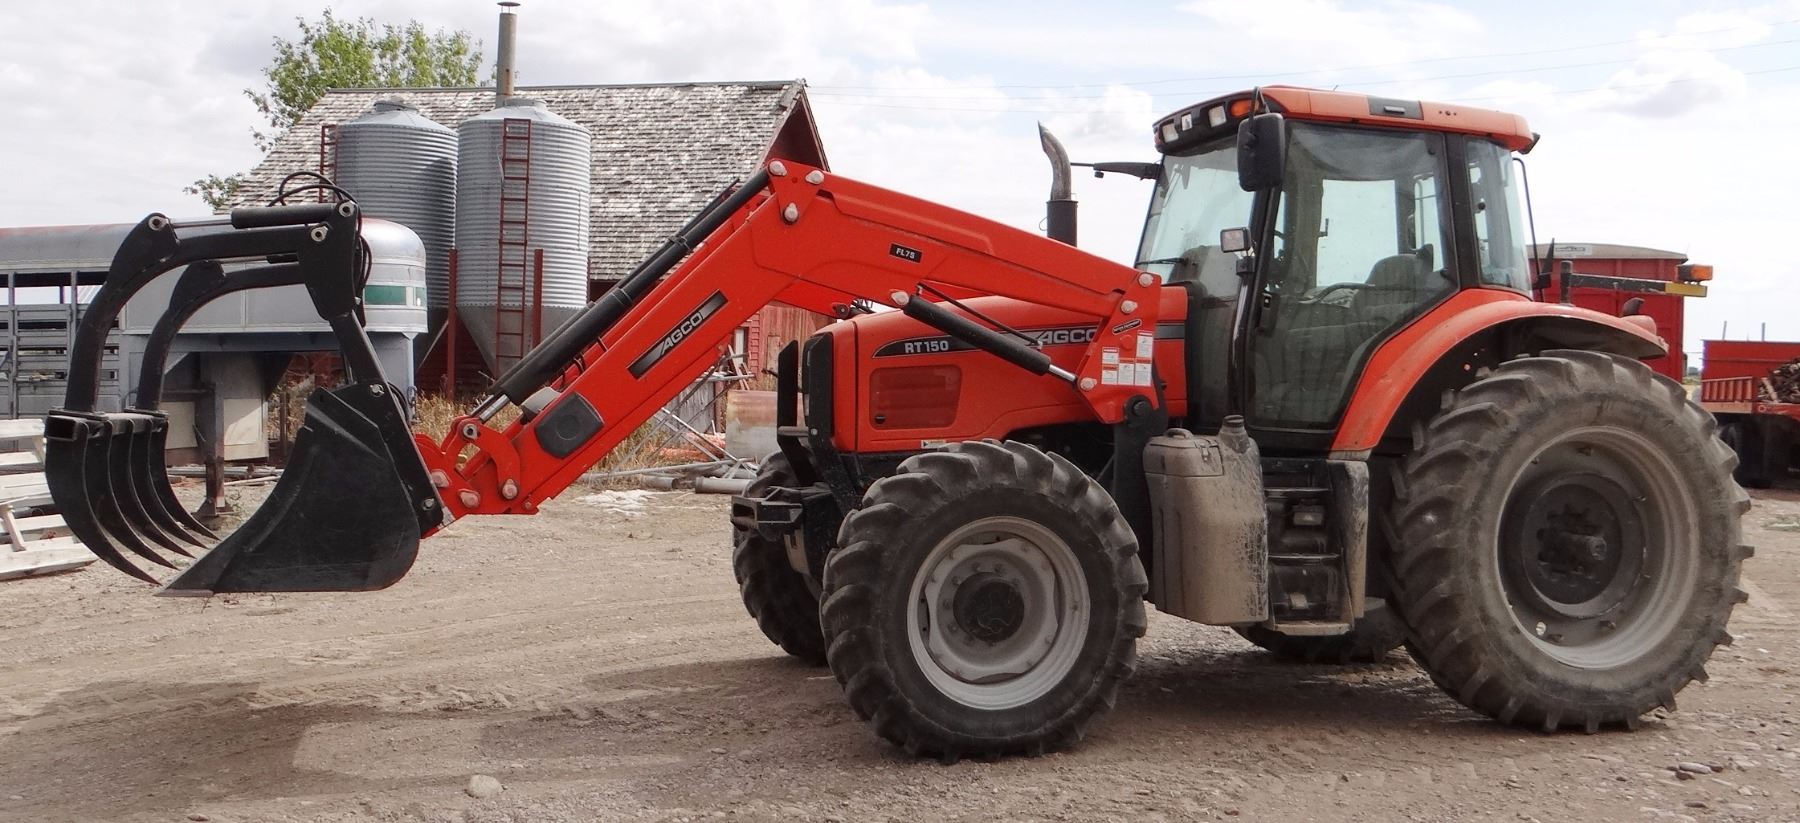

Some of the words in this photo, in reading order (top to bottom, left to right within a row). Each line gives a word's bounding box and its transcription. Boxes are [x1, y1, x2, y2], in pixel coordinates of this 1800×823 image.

[896, 247, 915, 259] FL75
[661, 312, 703, 355] AGCO
[904, 340, 949, 353] RT150
